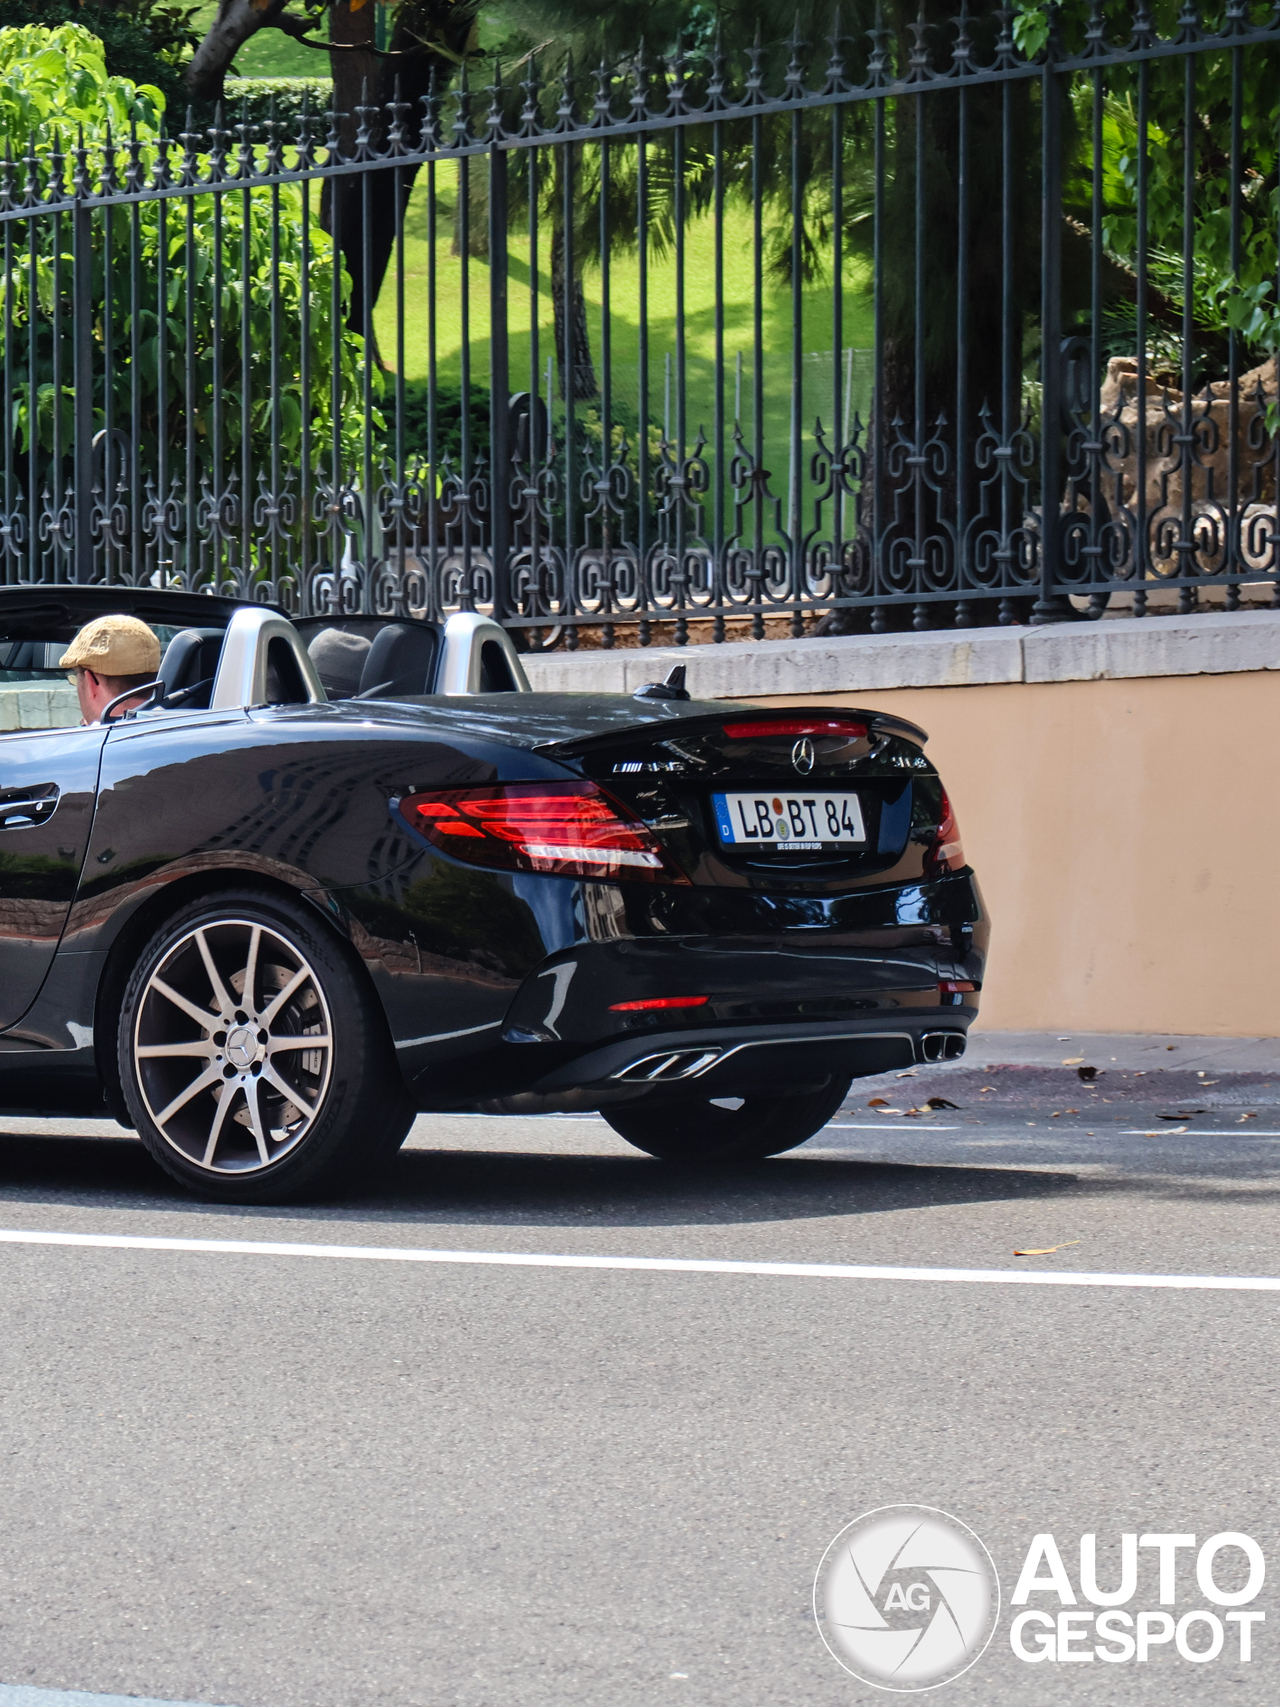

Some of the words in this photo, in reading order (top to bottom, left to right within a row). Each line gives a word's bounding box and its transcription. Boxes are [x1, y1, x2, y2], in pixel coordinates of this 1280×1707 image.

[722, 825, 730, 836] D
[737, 800, 774, 838] LB
[786, 800, 818, 838] BT
[825, 800, 855, 838] 84
